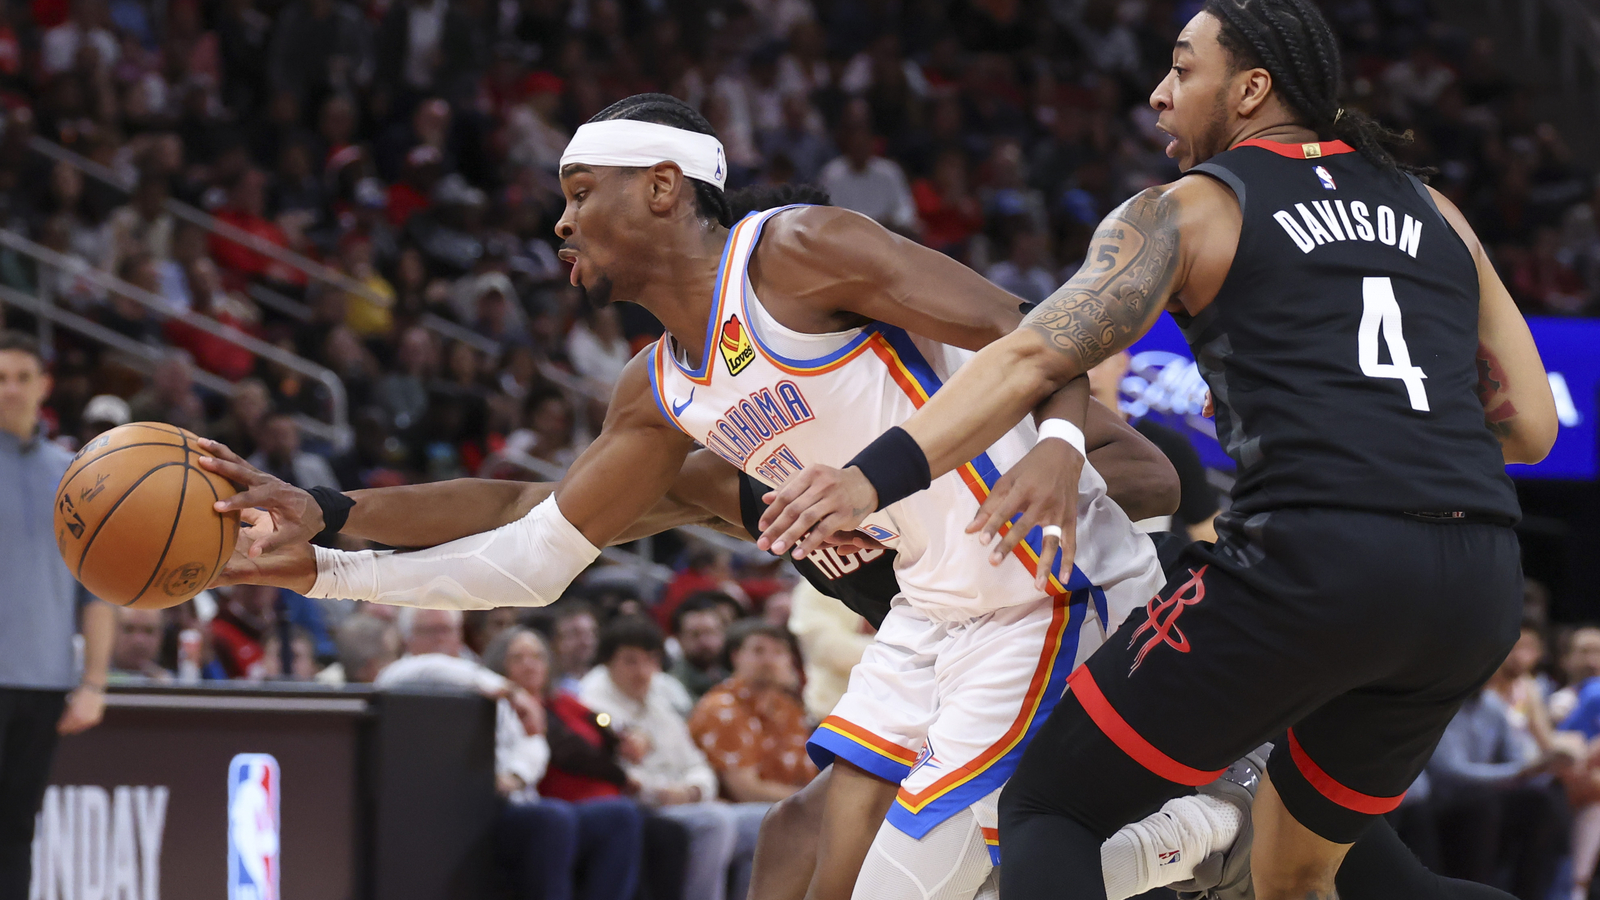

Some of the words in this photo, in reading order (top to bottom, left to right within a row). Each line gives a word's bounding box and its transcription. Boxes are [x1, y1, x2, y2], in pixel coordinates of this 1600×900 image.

[1272, 199, 1424, 259] DAVISON
[1357, 276, 1431, 412] 4
[29, 784, 170, 900] NDAY
